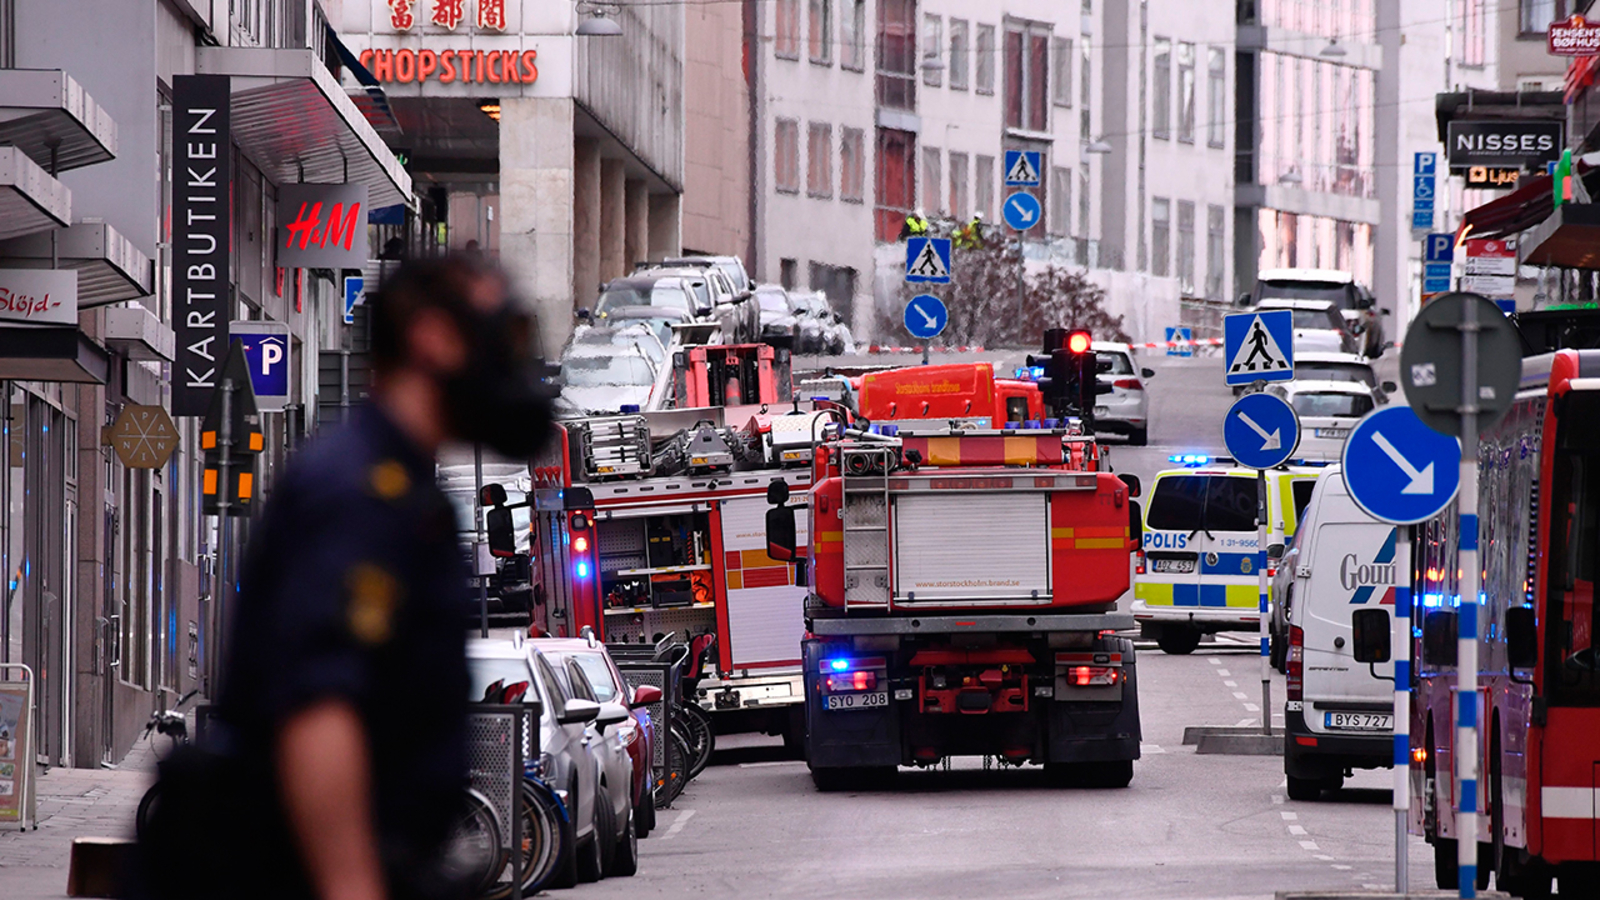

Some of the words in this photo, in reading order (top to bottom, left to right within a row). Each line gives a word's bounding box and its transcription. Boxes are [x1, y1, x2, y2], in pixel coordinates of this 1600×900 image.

[359, 49, 538, 84] CHOPSTICKS
[1457, 134, 1553, 151] NISSES
[1419, 154, 1433, 173] P
[286, 202, 361, 251] H&M
[186, 108, 217, 388] KARTBUTIKEN
[1433, 237, 1449, 260] P
[0, 287, 62, 318] Slöjd-
[262, 343, 283, 375] P
[1143, 533, 1187, 548] POLIS
[830, 695, 854, 708] SYO
[862, 693, 886, 706] 208
[1335, 714, 1360, 726] BYS
[1364, 715, 1389, 727] 727
